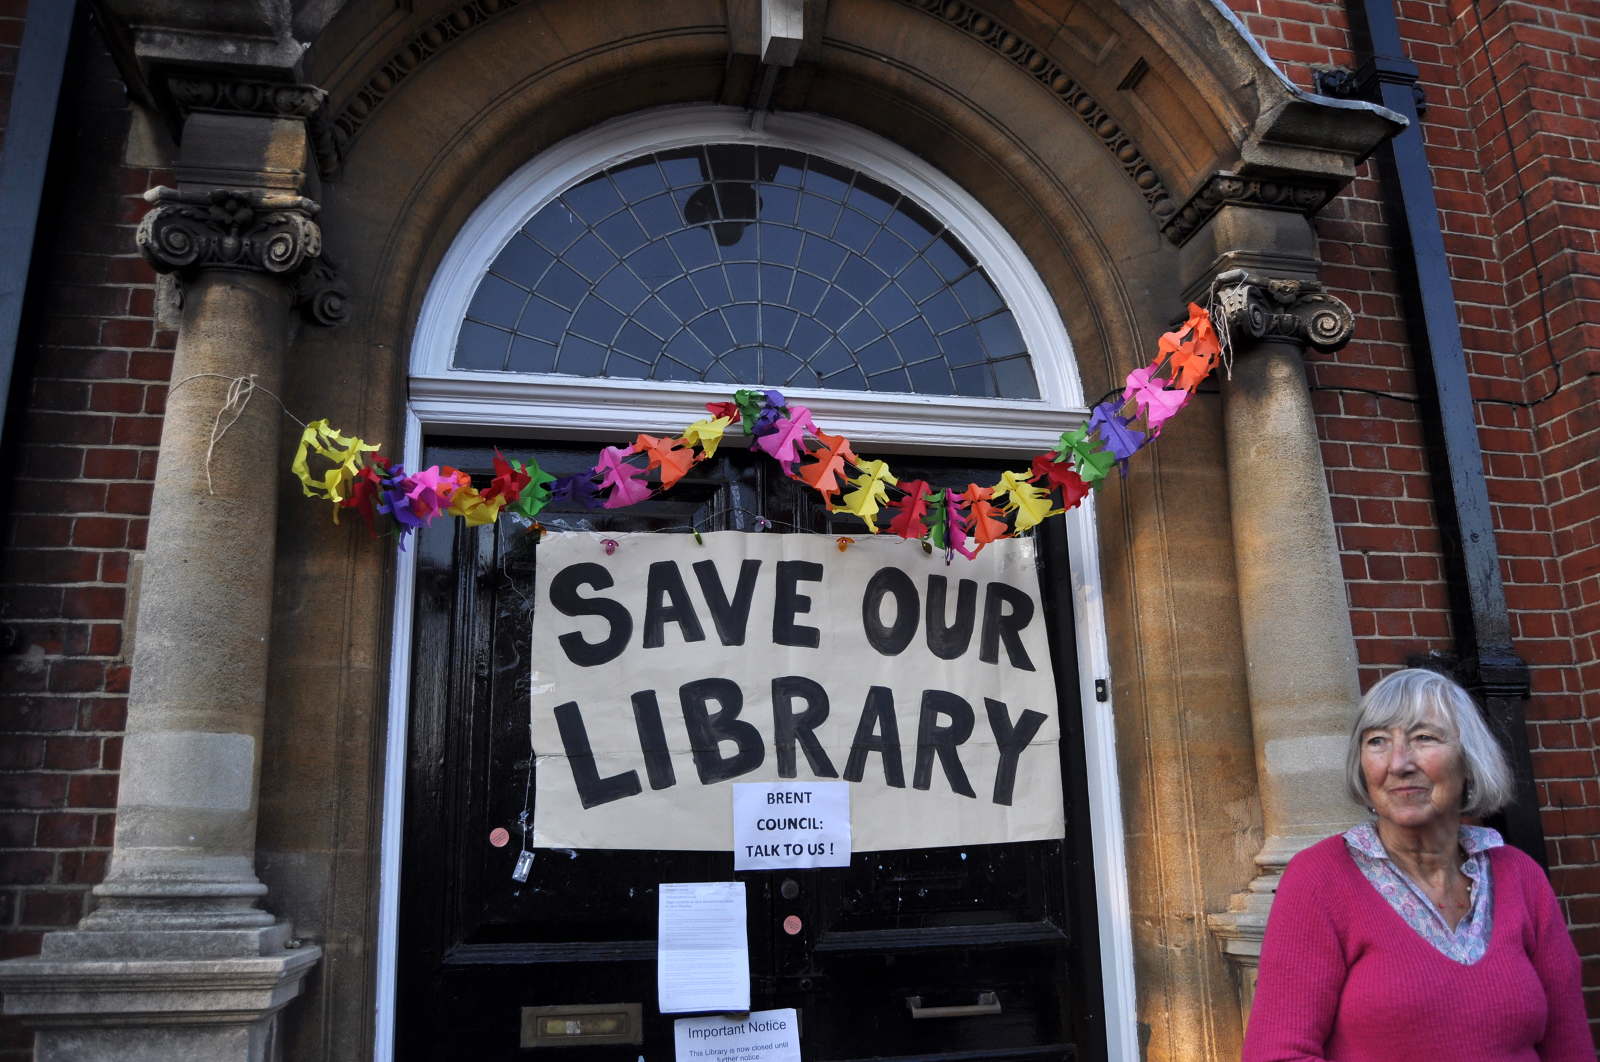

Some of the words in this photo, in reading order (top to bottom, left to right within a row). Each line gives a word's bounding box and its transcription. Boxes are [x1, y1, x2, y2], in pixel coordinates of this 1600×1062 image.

[549, 559, 823, 667] SAVE
[862, 566, 1037, 672] OUR
[553, 675, 1048, 809] LIBRARY
[767, 792, 812, 805] BRENT
[757, 818, 823, 831] COUNCIL:
[745, 844, 780, 857] TALK
[784, 843, 803, 856] TO
[807, 843, 825, 856] US
[688, 1023, 745, 1040] Important
[748, 1021, 787, 1033] Notice
[689, 1049, 703, 1057] This
[705, 1046, 728, 1057] Library
[751, 1042, 773, 1051] closed
